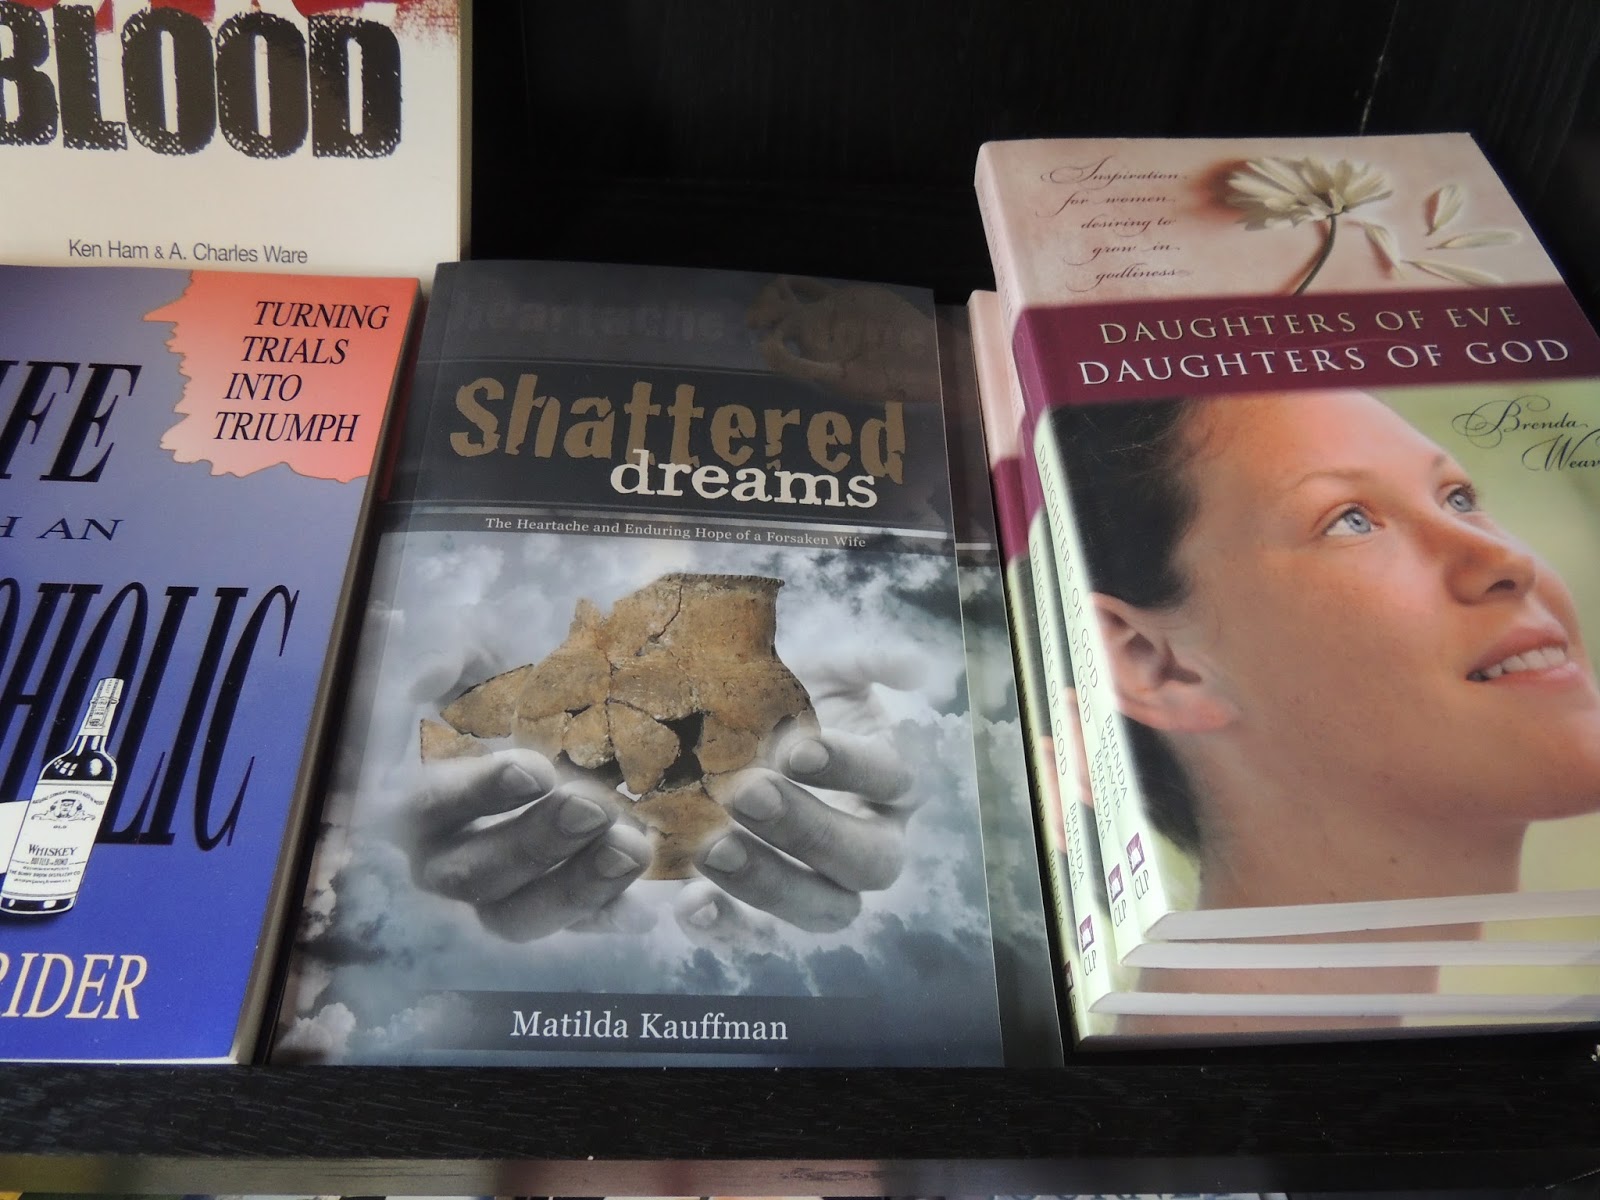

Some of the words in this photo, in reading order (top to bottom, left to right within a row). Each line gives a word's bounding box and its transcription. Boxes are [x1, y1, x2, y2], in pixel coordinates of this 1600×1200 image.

[1041, 155, 1180, 190] Inspiration
[1036, 191, 1088, 218] for
[1104, 196, 1170, 205] women
[1081, 214, 1151, 238] desiring
[1157, 217, 1177, 226] to
[69, 239, 102, 258] Ken
[108, 240, 149, 260] Ham
[154, 246, 165, 259] &
[169, 243, 187, 260] A.
[193, 242, 258, 263] Charles
[263, 245, 308, 264] Ware
[1063, 246, 1137, 266] grow
[1065, 263, 1183, 293] godliness
[254, 300, 390, 330] TURNING
[1099, 312, 1356, 344] DAUGHTERS
[1375, 310, 1424, 331] OF
[1446, 306, 1521, 328] EVE
[240, 335, 350, 365] TRIALS
[1079, 347, 1366, 385] DAUGHTERS
[1387, 344, 1442, 368] OF
[1465, 339, 1569, 365] GOD
[223, 372, 303, 402] INTO
[213, 411, 361, 442] TRIUMPH
[450, 373, 906, 485] Shattered
[1452, 395, 1588, 449] Brenda
[610, 449, 878, 508] dreams
[36, 517, 125, 541] AN
[486, 518, 512, 529] The
[517, 519, 589, 532] Heartache
[593, 523, 620, 533] and
[624, 524, 691, 538] Enduring
[695, 528, 732, 541] Hope
[736, 530, 752, 541] of
[754, 533, 761, 542] a
[767, 532, 829, 546] Forsaken
[834, 536, 866, 547] Wife
[1039, 444, 1075, 582] DAUGHTERS
[1071, 587, 1084, 619] OF
[1081, 628, 1099, 690] GOD
[1032, 541, 1055, 674] DAUGHTERS
[1050, 680, 1060, 709] OF
[1077, 664, 1091, 724] GOD
[0, 576, 299, 852] HOLIC
[1054, 719, 1069, 776] GOD
[1105, 713, 1128, 801] BRENDA
[1100, 727, 1121, 816] WEAVER
[1095, 750, 1113, 833] BRENDA
[28, 843, 79, 857] WHISKEY
[1069, 802, 1086, 884] BRENDA
[1134, 868, 1150, 901] CLP
[1114, 899, 1127, 928] CLP
[1083, 949, 1097, 977] CLP
[510, 1010, 628, 1038] Matilda
[639, 1012, 788, 1041] Kauffman
